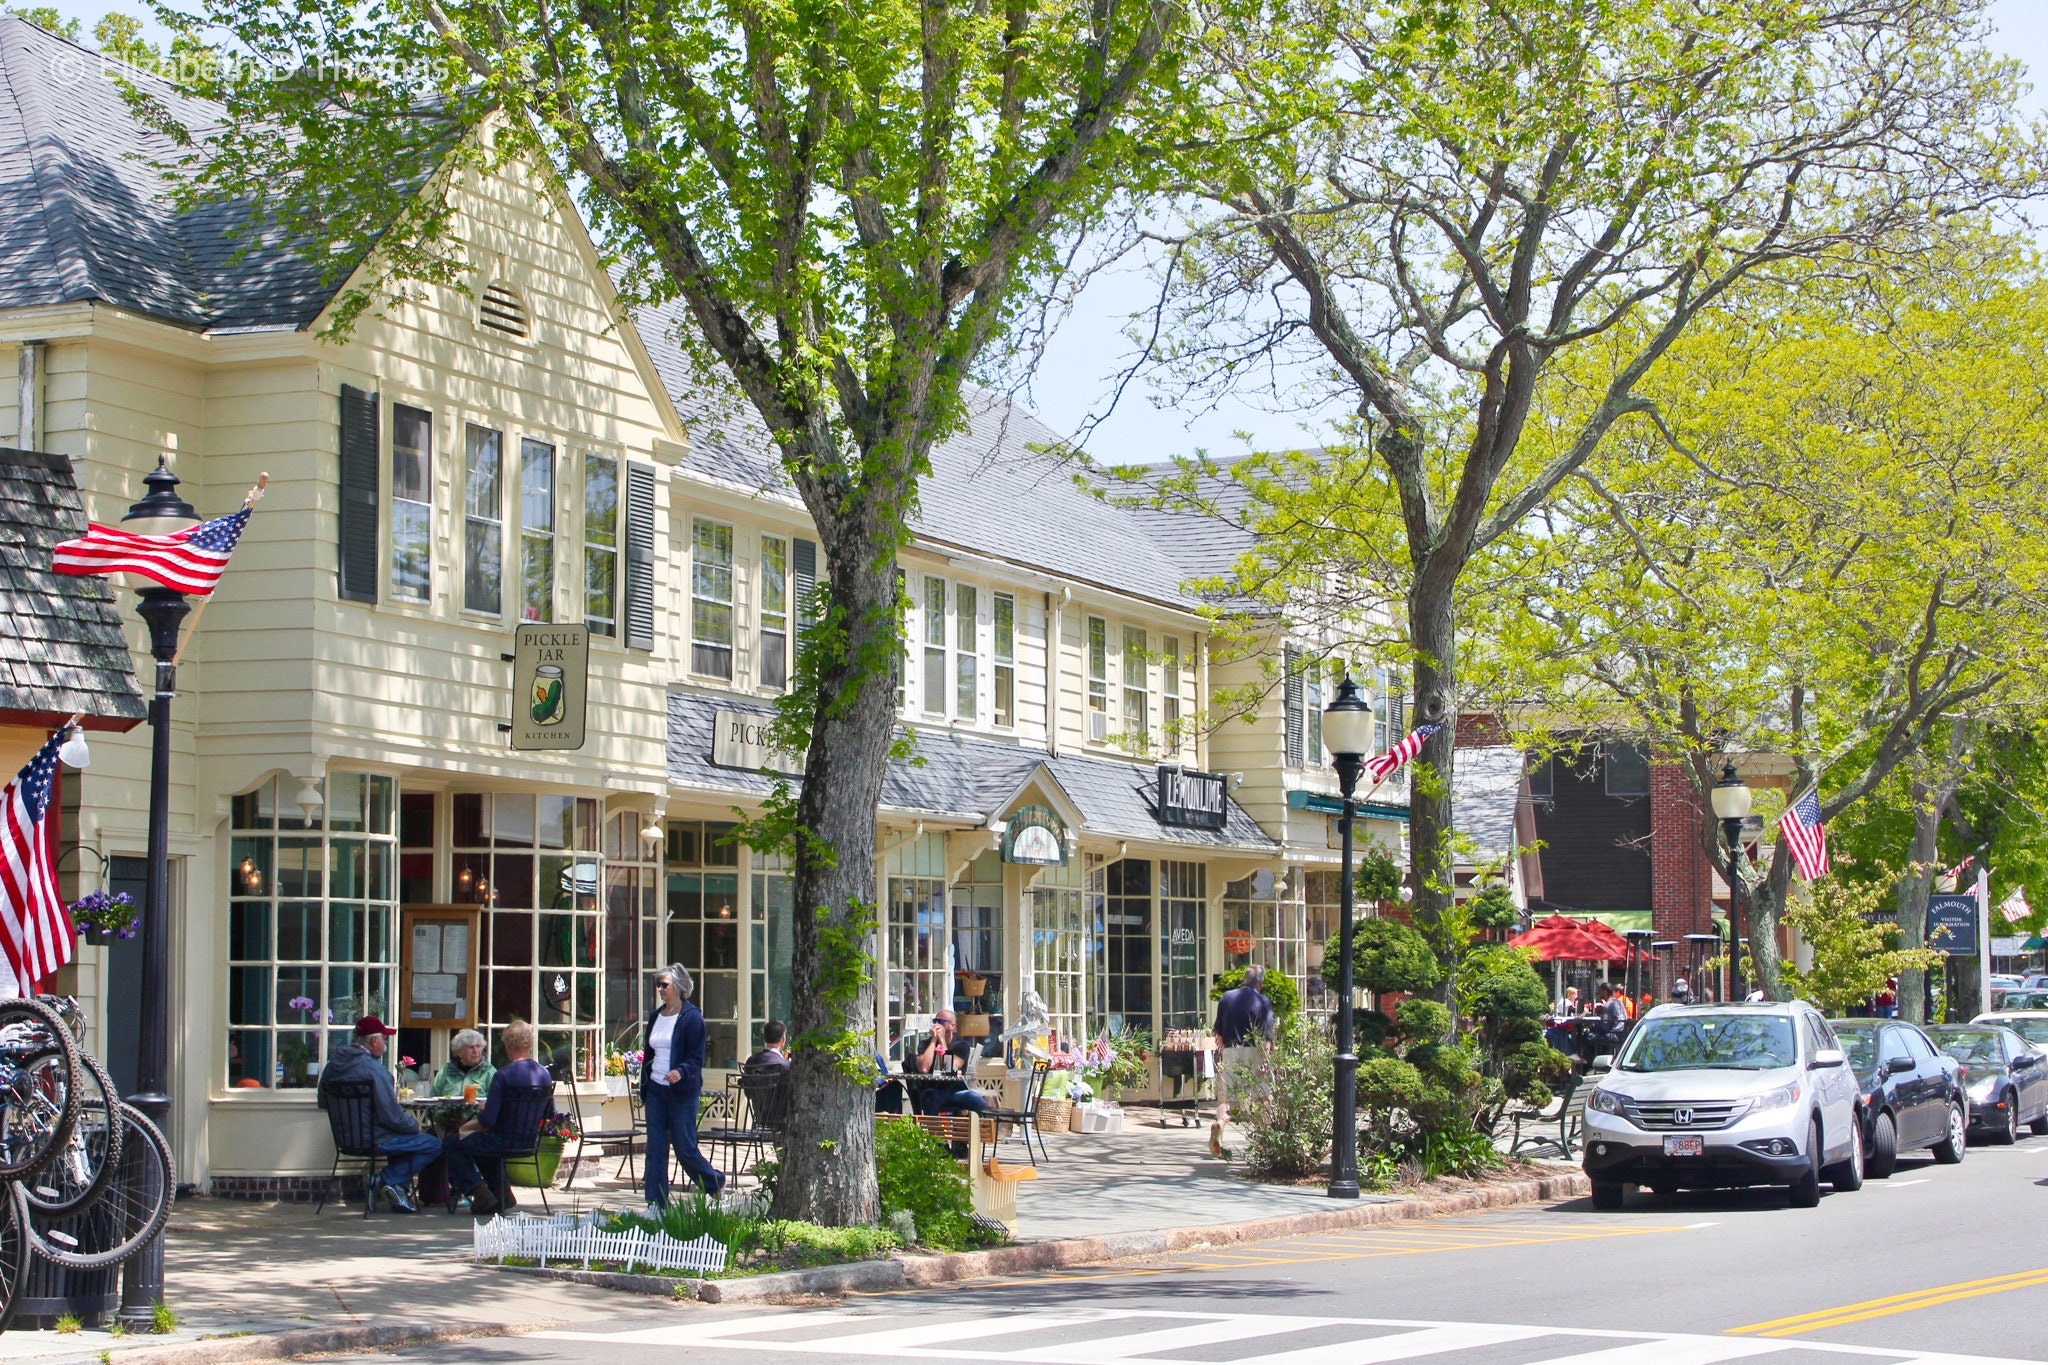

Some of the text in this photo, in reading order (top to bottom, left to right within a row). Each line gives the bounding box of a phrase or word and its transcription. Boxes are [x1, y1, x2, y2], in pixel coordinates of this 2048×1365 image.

[524, 633, 580, 646] PICKLE
[536, 649, 565, 663] JAR
[730, 722, 784, 748] PICK
[1166, 773, 1222, 813] LEMONLIME
[1931, 901, 1972, 914] FALMOUTH
[1172, 928, 1195, 941] AVEDA
